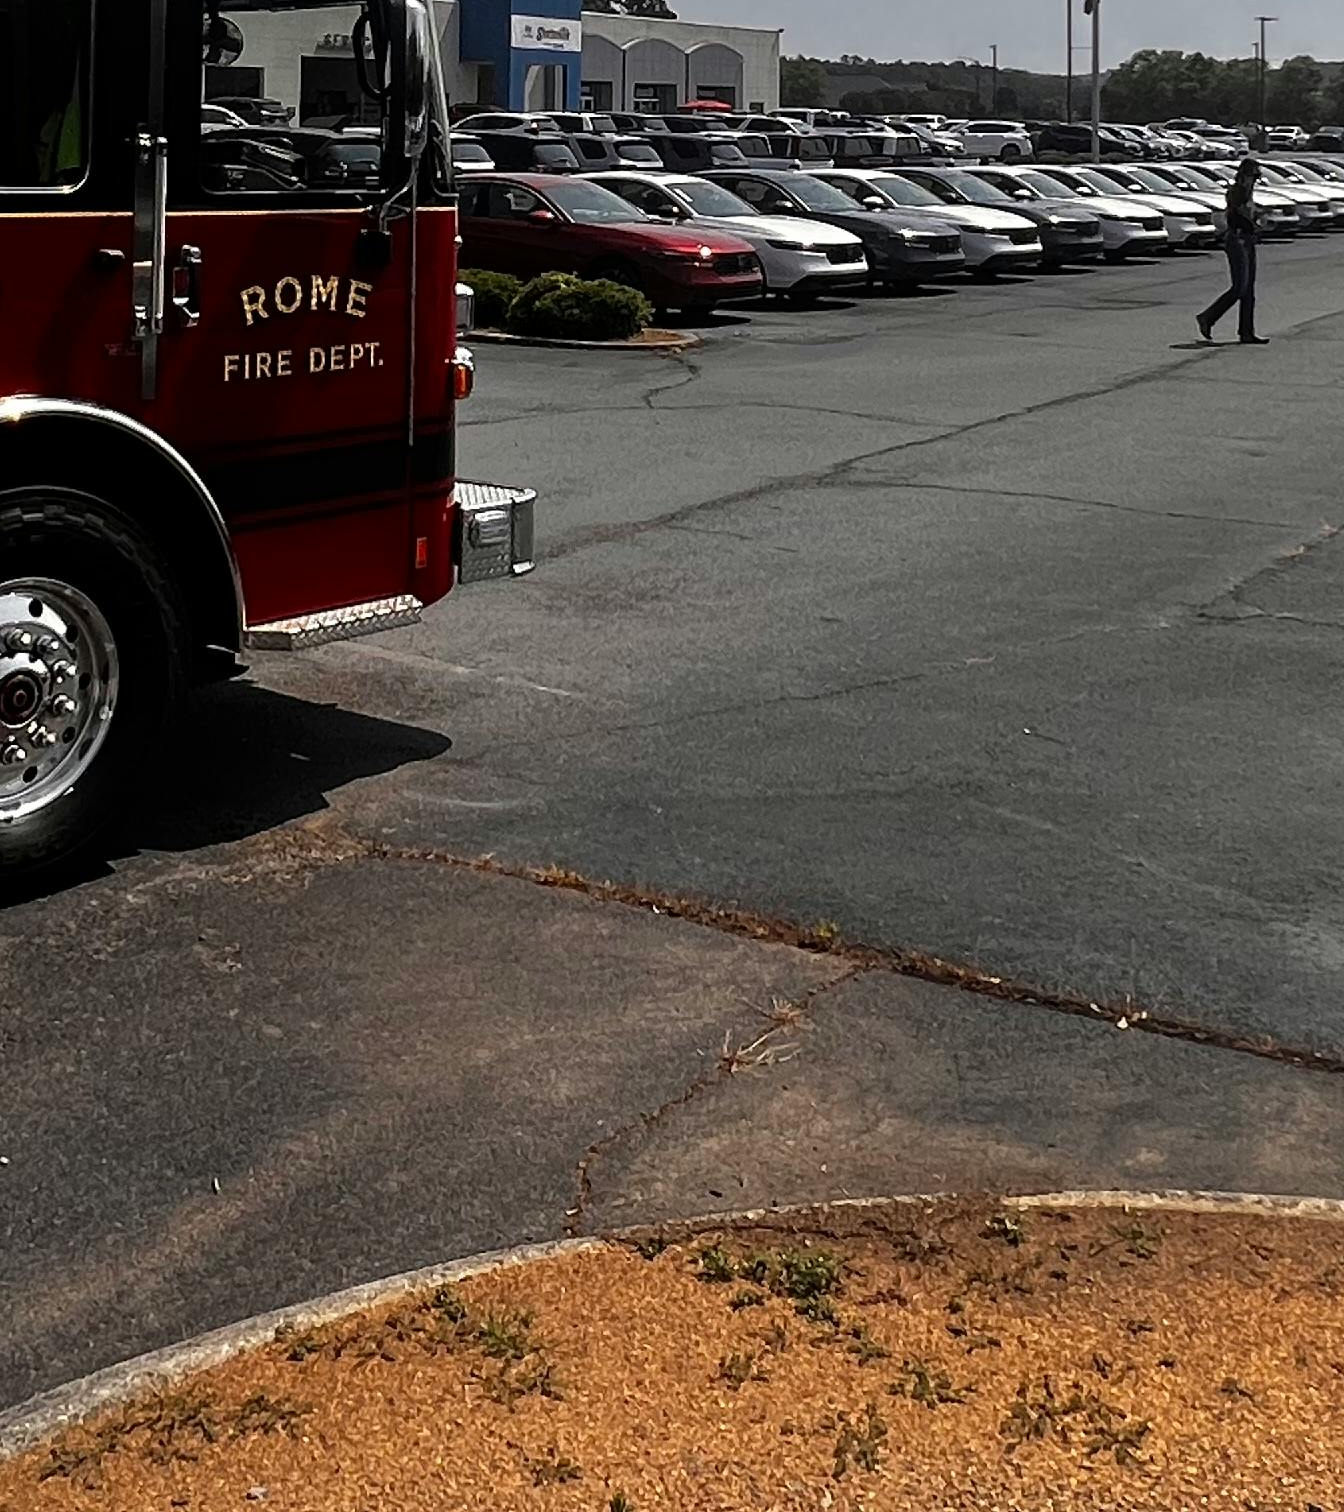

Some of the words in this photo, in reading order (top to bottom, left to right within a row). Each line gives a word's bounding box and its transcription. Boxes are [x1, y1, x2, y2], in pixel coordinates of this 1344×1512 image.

[240, 275, 373, 326] ROME
[224, 350, 292, 381] FIRE
[309, 342, 383, 374] DEPT.
